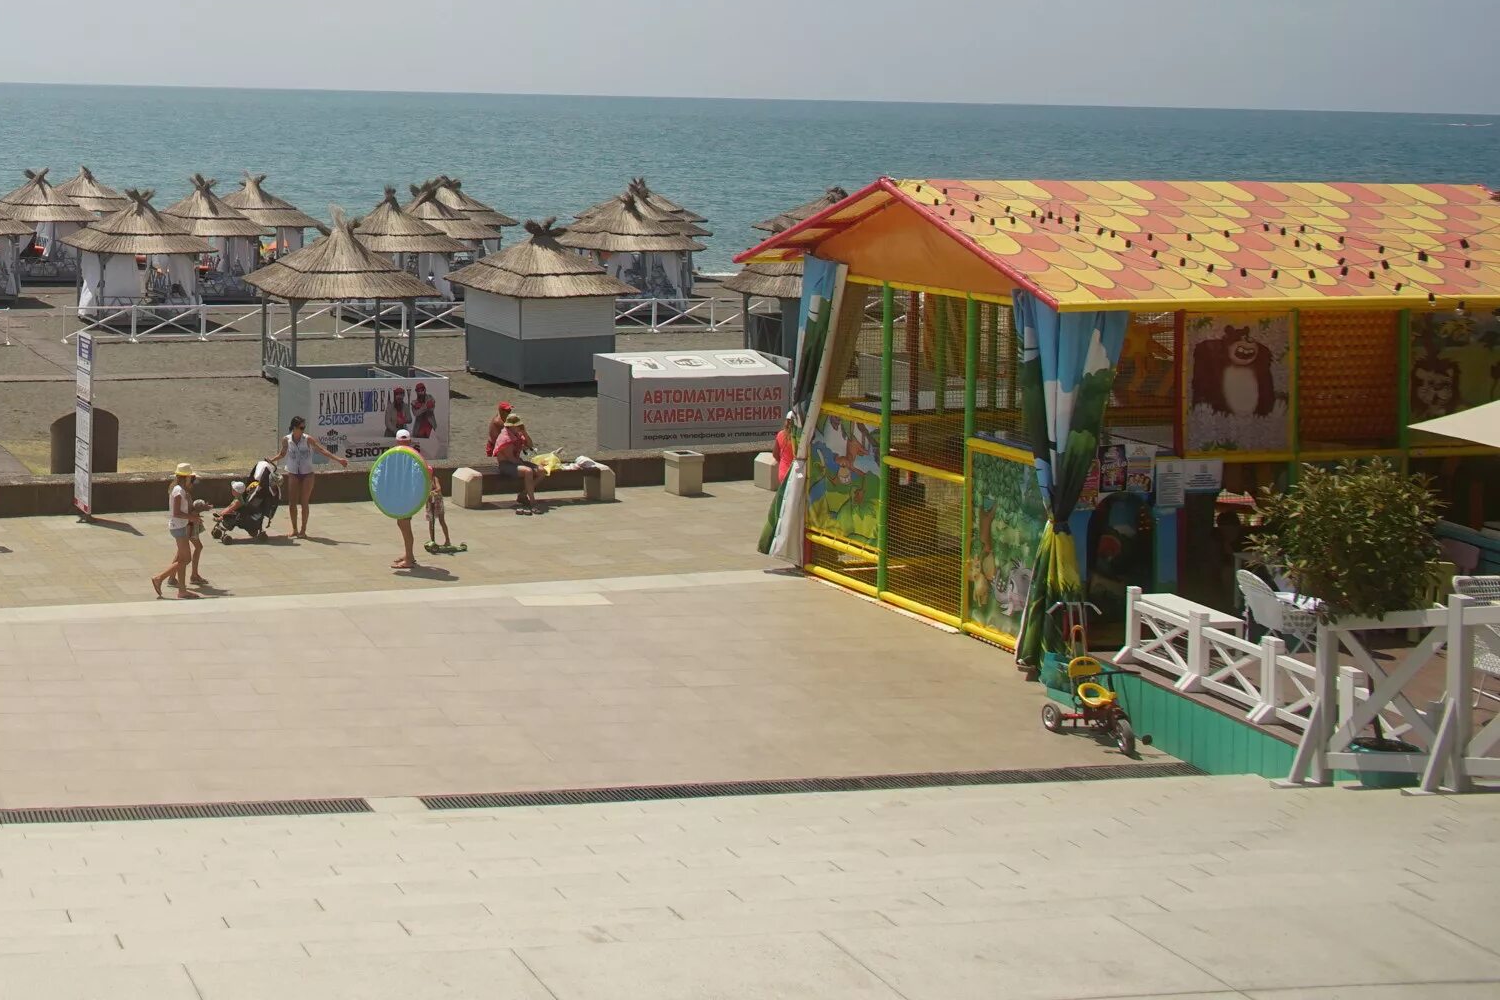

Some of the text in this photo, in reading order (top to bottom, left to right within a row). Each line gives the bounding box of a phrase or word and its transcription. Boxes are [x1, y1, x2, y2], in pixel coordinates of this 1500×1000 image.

[319, 389, 411, 415] FASHION BEAY
[643, 387, 782, 404] АВТОМАТИЧЕСКАЯ
[318, 413, 364, 426] 25 ИЮНЯ
[643, 406, 782, 424] КАМЕРА ХРАНЕНИЯ
[680, 431, 726, 439] телефонов
